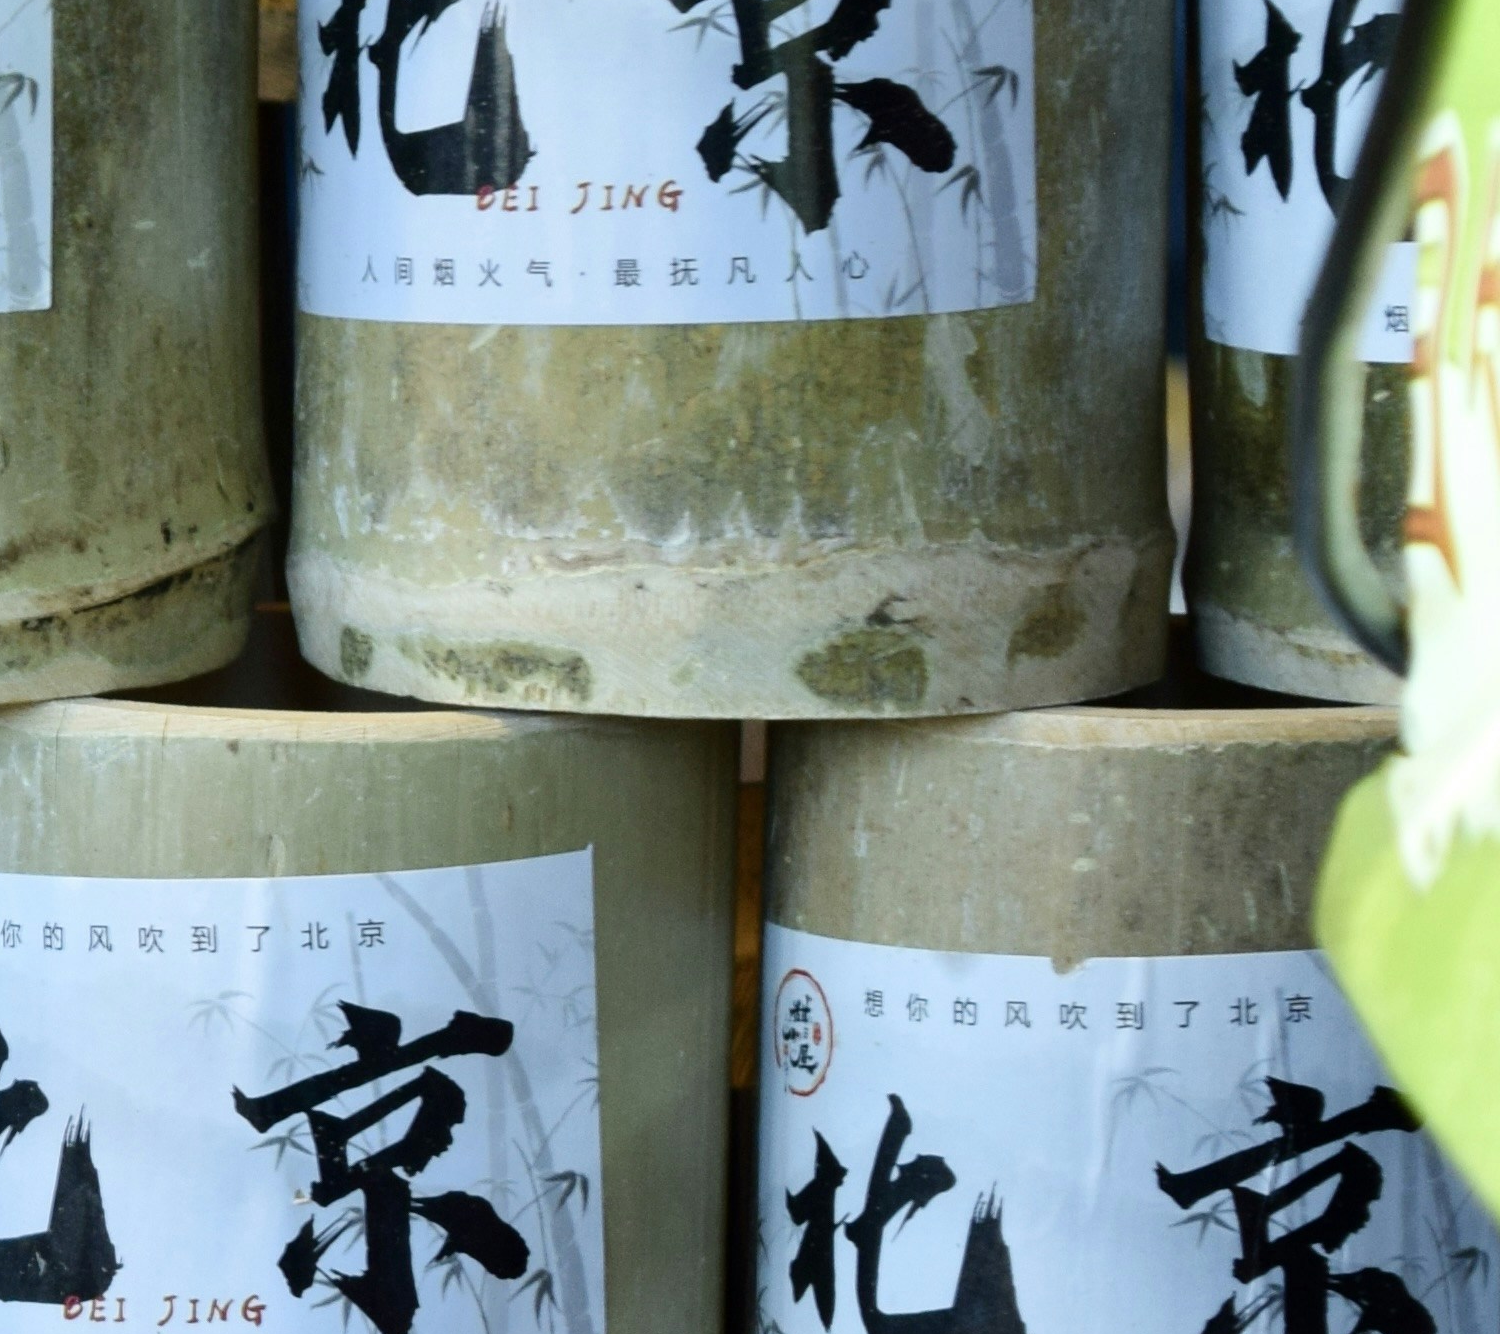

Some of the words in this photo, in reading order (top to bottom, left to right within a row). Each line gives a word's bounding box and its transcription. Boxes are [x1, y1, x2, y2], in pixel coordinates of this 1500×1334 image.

[475, 182, 540, 213] BEI
[569, 182, 684, 213] JING
[863, 989, 1314, 1031] 想你的风吹到了北京
[62, 1296, 126, 1322] BEI
[157, 1294, 267, 1326] JING
